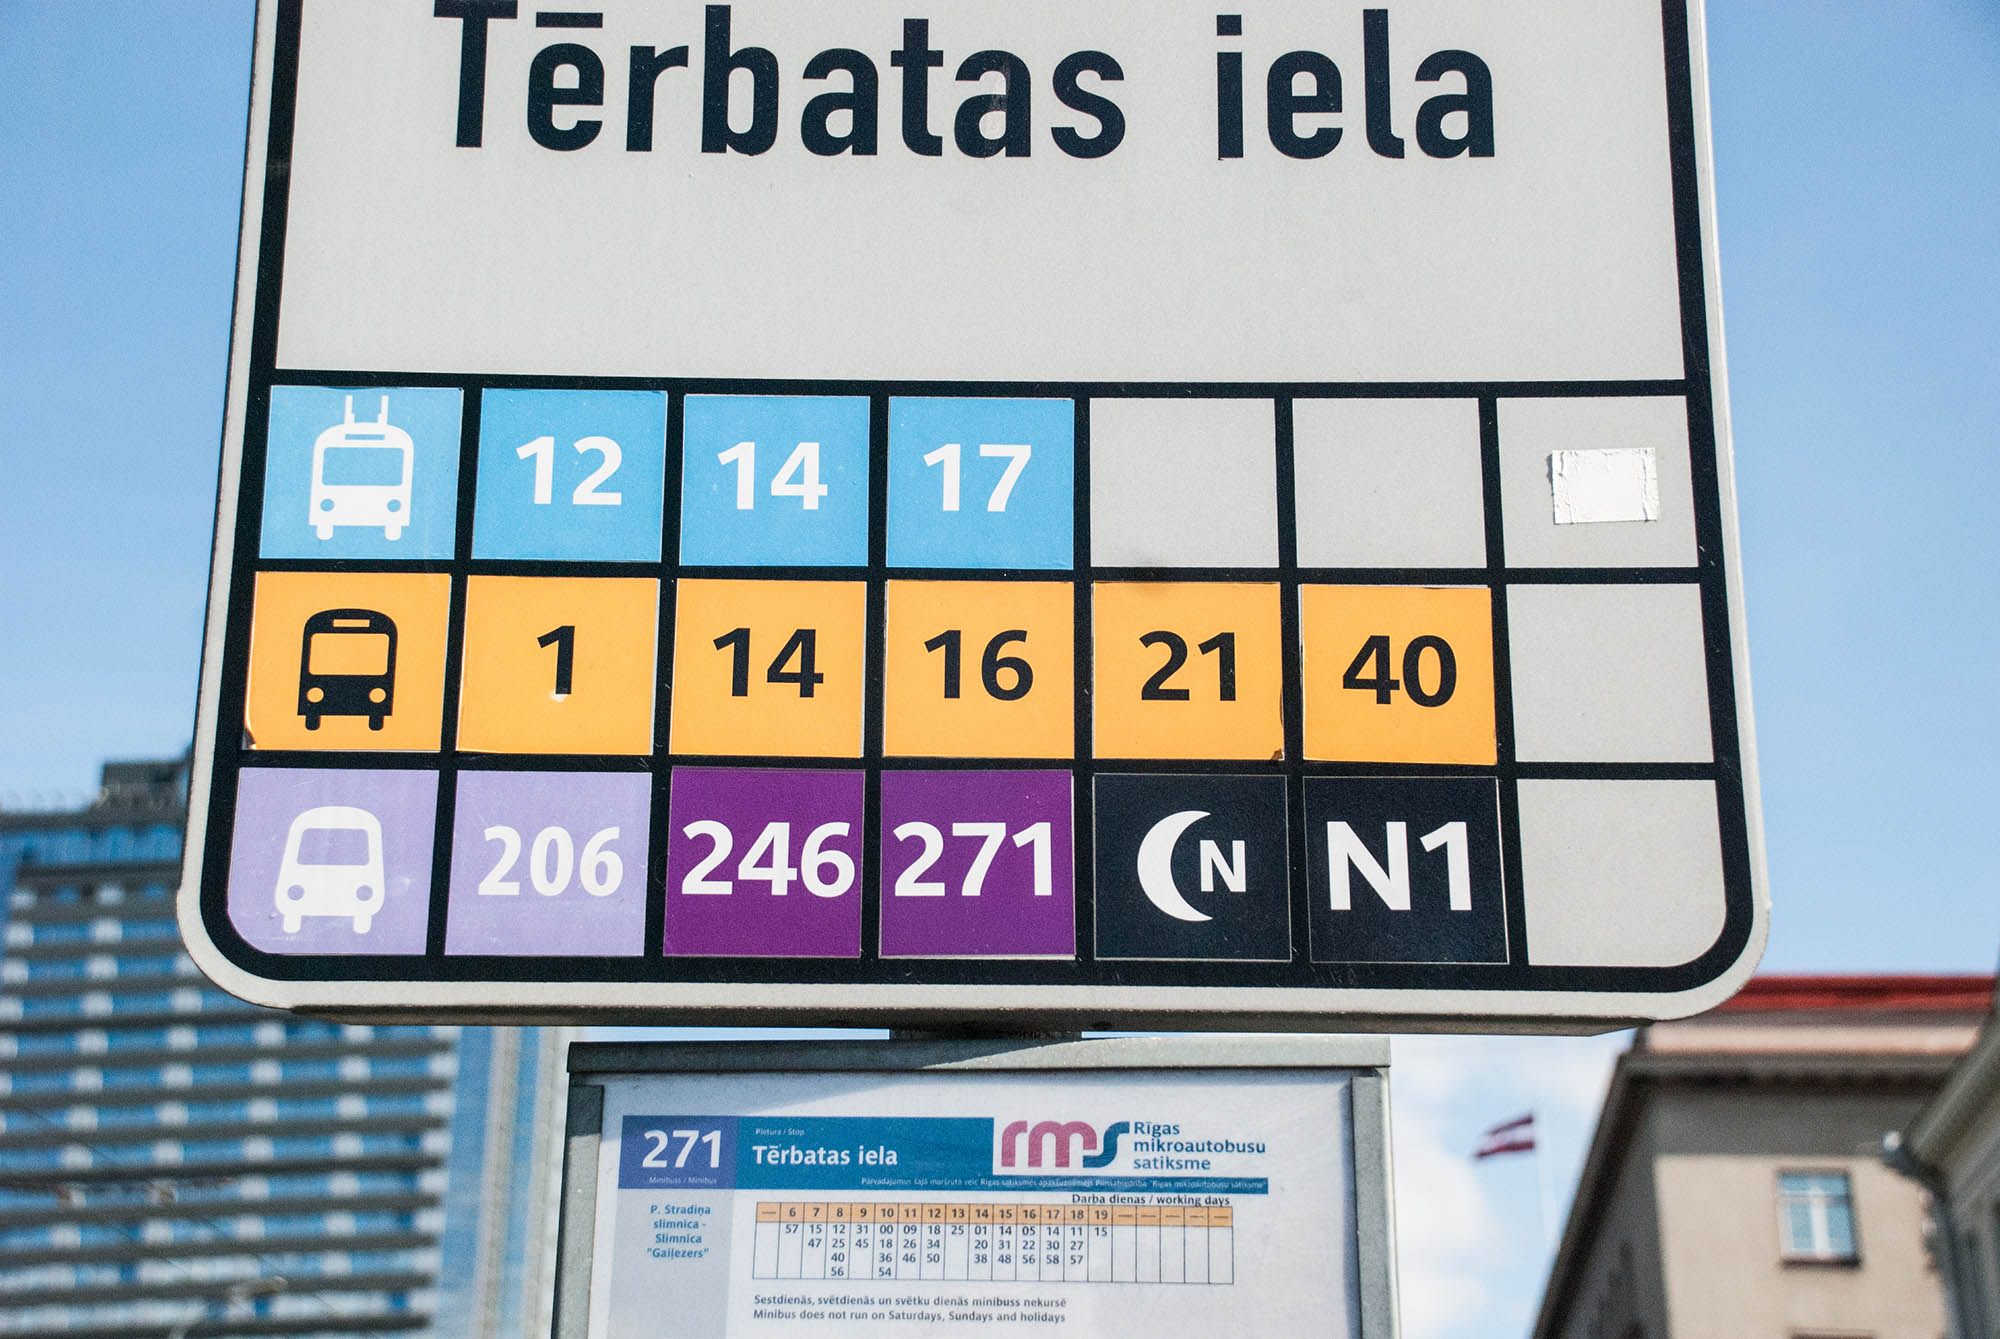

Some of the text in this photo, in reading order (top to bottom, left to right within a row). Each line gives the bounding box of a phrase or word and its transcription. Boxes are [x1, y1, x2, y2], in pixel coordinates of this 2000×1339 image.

[433, 0, 1496, 161] Tērbatas iela
[516, 435, 1033, 513] 12 14 17
[537, 625, 1457, 707] 1 14 16 21 40
[477, 820, 1472, 912] 206 246 271 N N1
[788, 1128, 804, 1136] Stop
[1134, 1121, 1180, 1137] Rīgas
[642, 1130, 721, 1168] 271
[1134, 1139, 1266, 1153] mikroautobusu
[752, 1145, 897, 1165] Tērbatas iela
[1133, 1156, 1211, 1170] satiksme
[1072, 1194, 1105, 1204] Darba
[1109, 1194, 1146, 1205] dienas
[1156, 1195, 1200, 1207] working
[1204, 1196, 1230, 1207] days
[650, 1205, 660, 1214] P.
[789, 1207, 1108, 1220] 6 7 8 9 10 11 12 13 14 15 16 17 18 19
[654, 1219, 699, 1229] slimnica
[786, 1224, 1107, 1237] 57 15 12 31 00 09 18 25 01 14 05 14 11 15
[656, 1234, 702, 1243] Slimnica
[808, 1239, 1084, 1250] 47 25 45 18 26 34 20 31 22 30 27
[831, 1252, 1083, 1265] 40 36 46 50 38 48 56 58 57
[831, 1267, 891, 1277] 56 54
[754, 1295, 815, 1306] Sestdienās,
[818, 1295, 874, 1305] svētdienās
[895, 1297, 930, 1306] svētku
[934, 1296, 968, 1306] dienās
[972, 1297, 1020, 1307] minibuss
[754, 1309, 796, 1319] Minibus
[800, 1310, 824, 1319] does
[889, 1311, 945, 1322] Saturdays,
[949, 1311, 993, 1323] Sundays
[996, 1312, 1017, 1321] and
[1021, 1312, 1065, 1323] holidays
